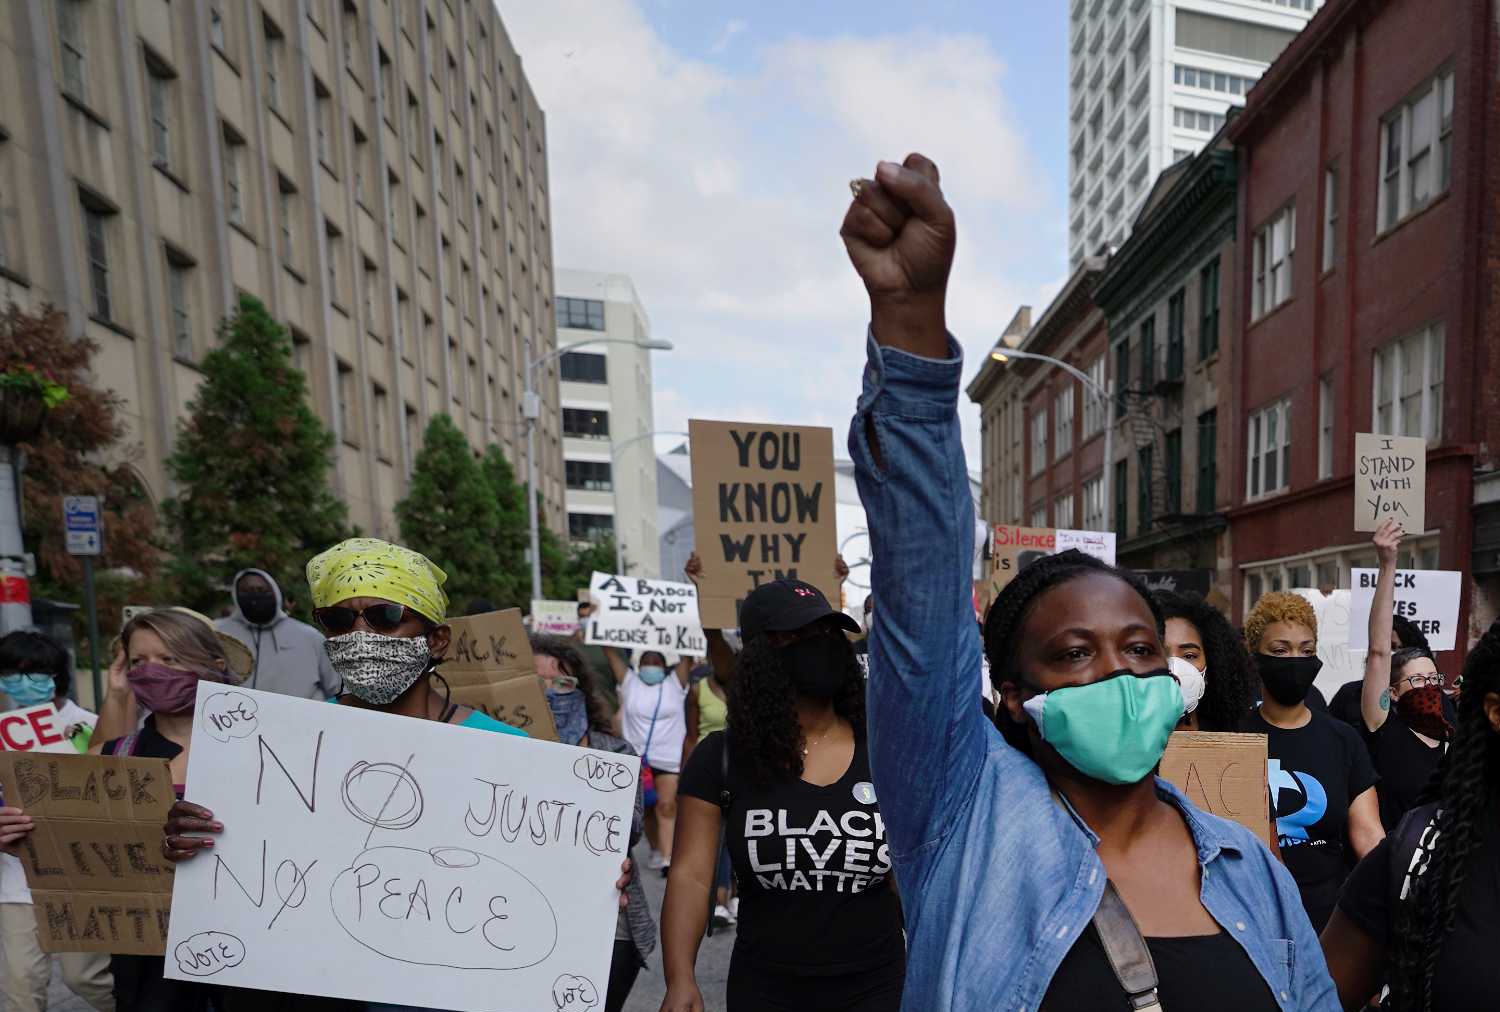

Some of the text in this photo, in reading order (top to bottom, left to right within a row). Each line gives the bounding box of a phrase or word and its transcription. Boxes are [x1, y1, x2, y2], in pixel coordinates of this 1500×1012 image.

[730, 430, 800, 471] YOU
[1381, 439, 1393, 449] I
[1360, 455, 1415, 475] STAND
[719, 482, 823, 524] KNOW
[719, 533, 808, 563] WHY
[995, 526, 1056, 548] Silence
[996, 553, 1010, 570] is
[598, 576, 627, 593] A
[1359, 573, 1416, 589] BLCK
[640, 613, 656, 626] A
[0, 708, 64, 752] CE
[207, 702, 257, 732] VOTE
[14, 758, 162, 808] BLACK
[586, 759, 630, 786] VOTE
[464, 777, 626, 856] JUSTICE
[23, 838, 175, 879] LIVE
[747, 837, 893, 874] LIVES
[353, 863, 516, 951] PEACE
[183, 942, 234, 970] VOTE
[554, 983, 591, 1009] VOTE
